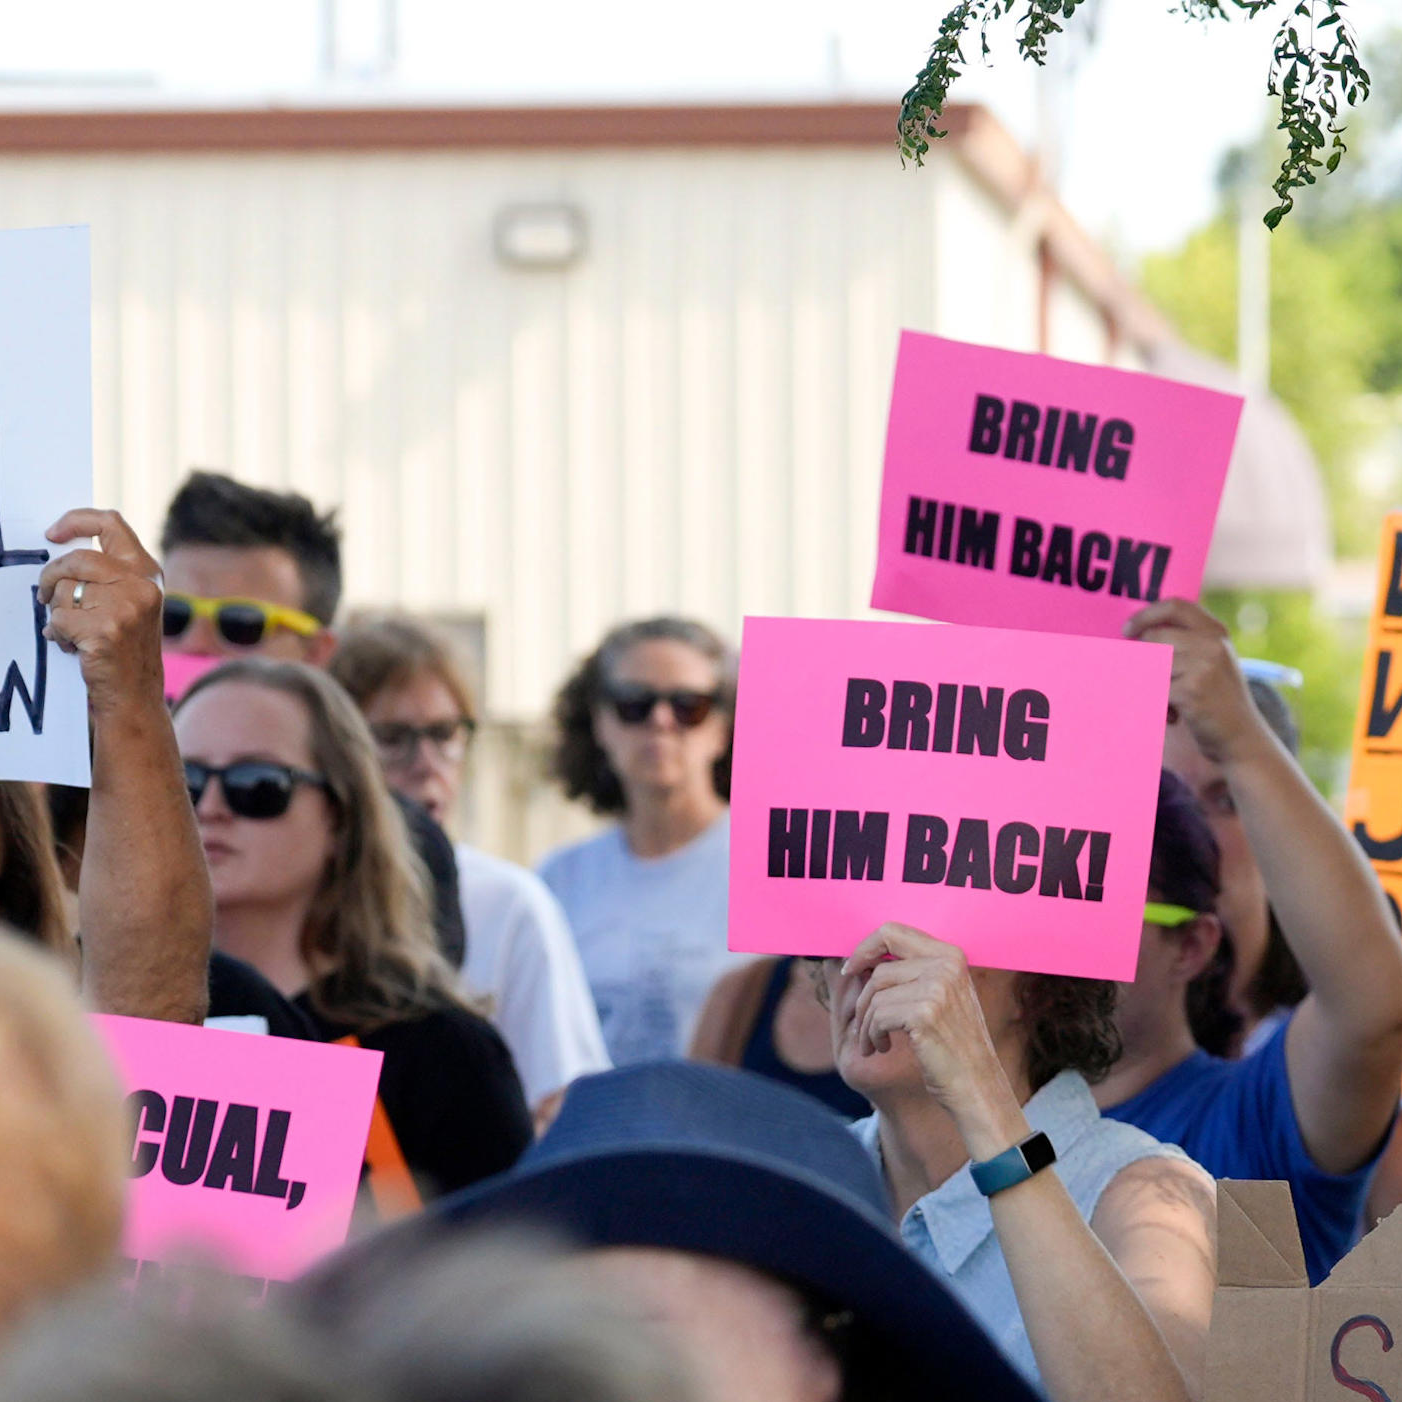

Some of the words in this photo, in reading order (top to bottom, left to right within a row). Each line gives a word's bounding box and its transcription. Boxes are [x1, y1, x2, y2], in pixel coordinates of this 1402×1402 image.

[968, 392, 1136, 481] BRING
[902, 495, 1003, 571] HIM
[1008, 515, 1173, 603] BACK!
[840, 676, 1050, 762] BRING
[767, 806, 890, 882] HIM
[901, 812, 1112, 903] BACK!
